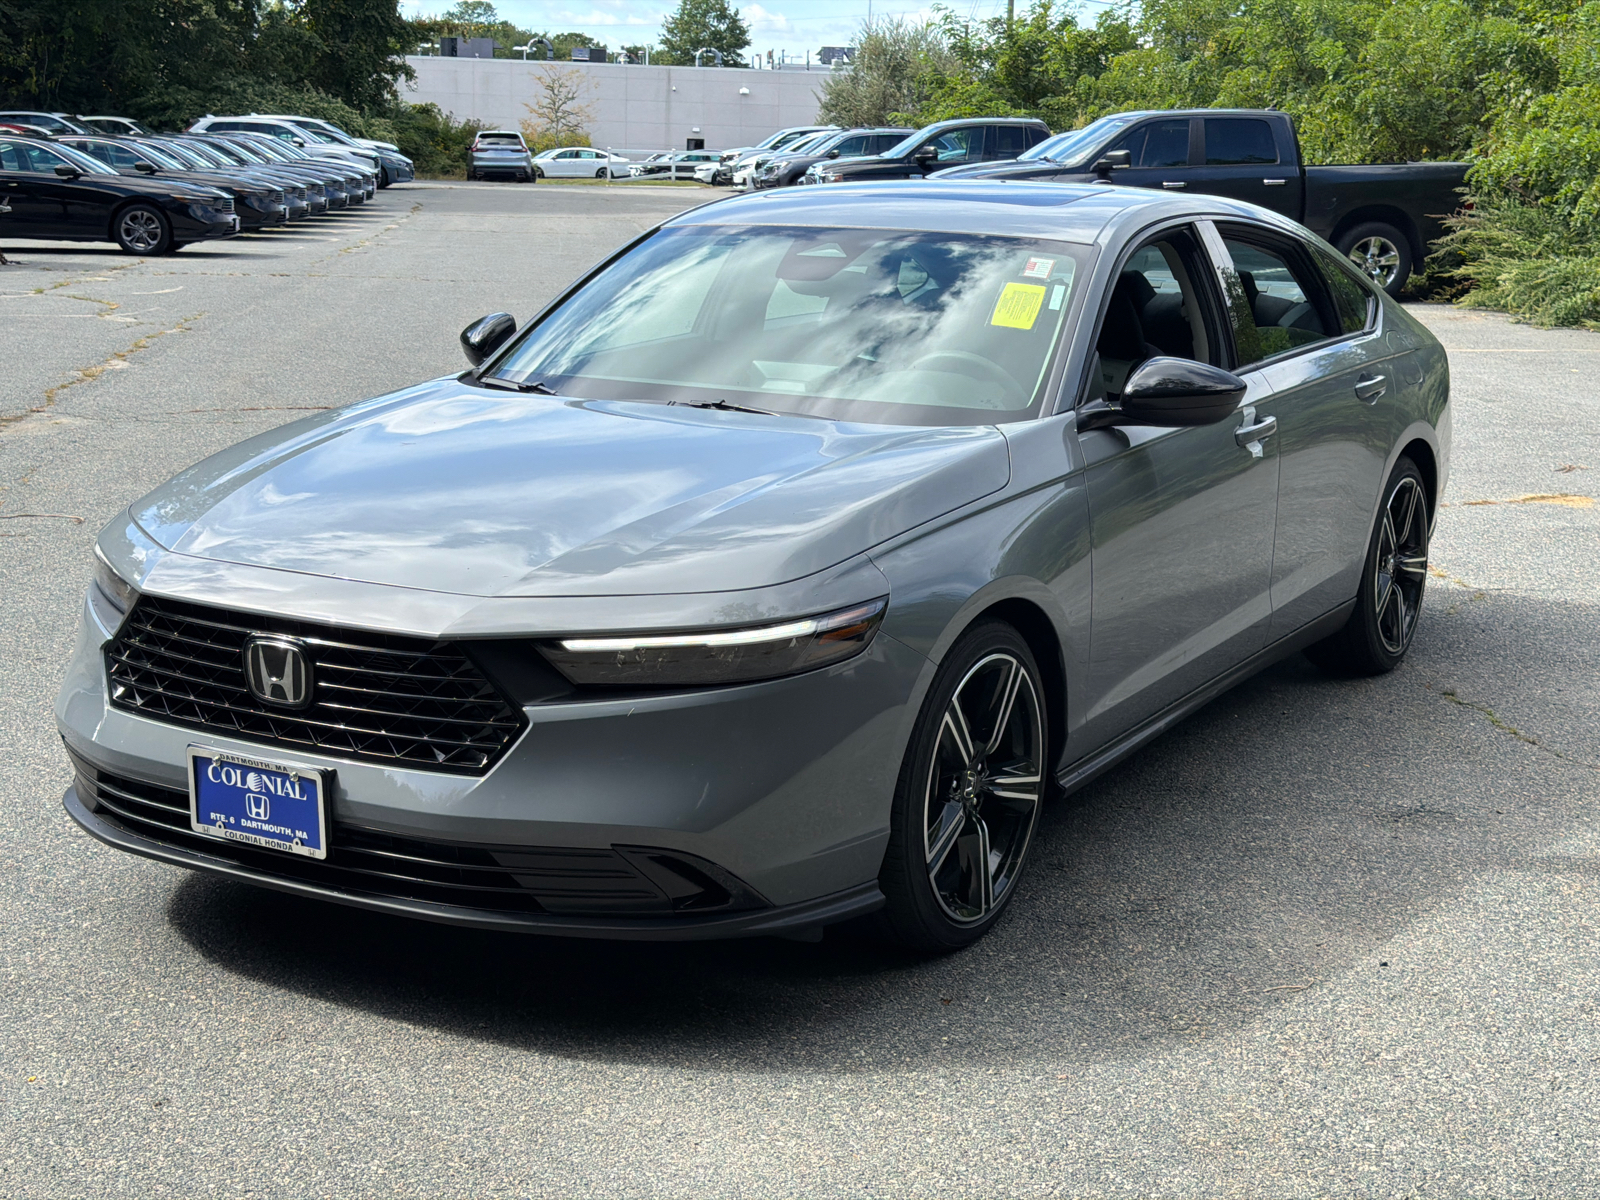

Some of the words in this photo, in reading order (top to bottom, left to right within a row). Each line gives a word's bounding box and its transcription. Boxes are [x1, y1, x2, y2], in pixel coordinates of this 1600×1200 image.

[208, 764, 307, 800] COLONIAL
[210, 812, 228, 822] RTE.
[241, 818, 294, 838] DARTMOUTH,
[296, 830, 308, 840] MA
[224, 830, 262, 845] COLONIAL
[264, 837, 293, 852] HONDA
